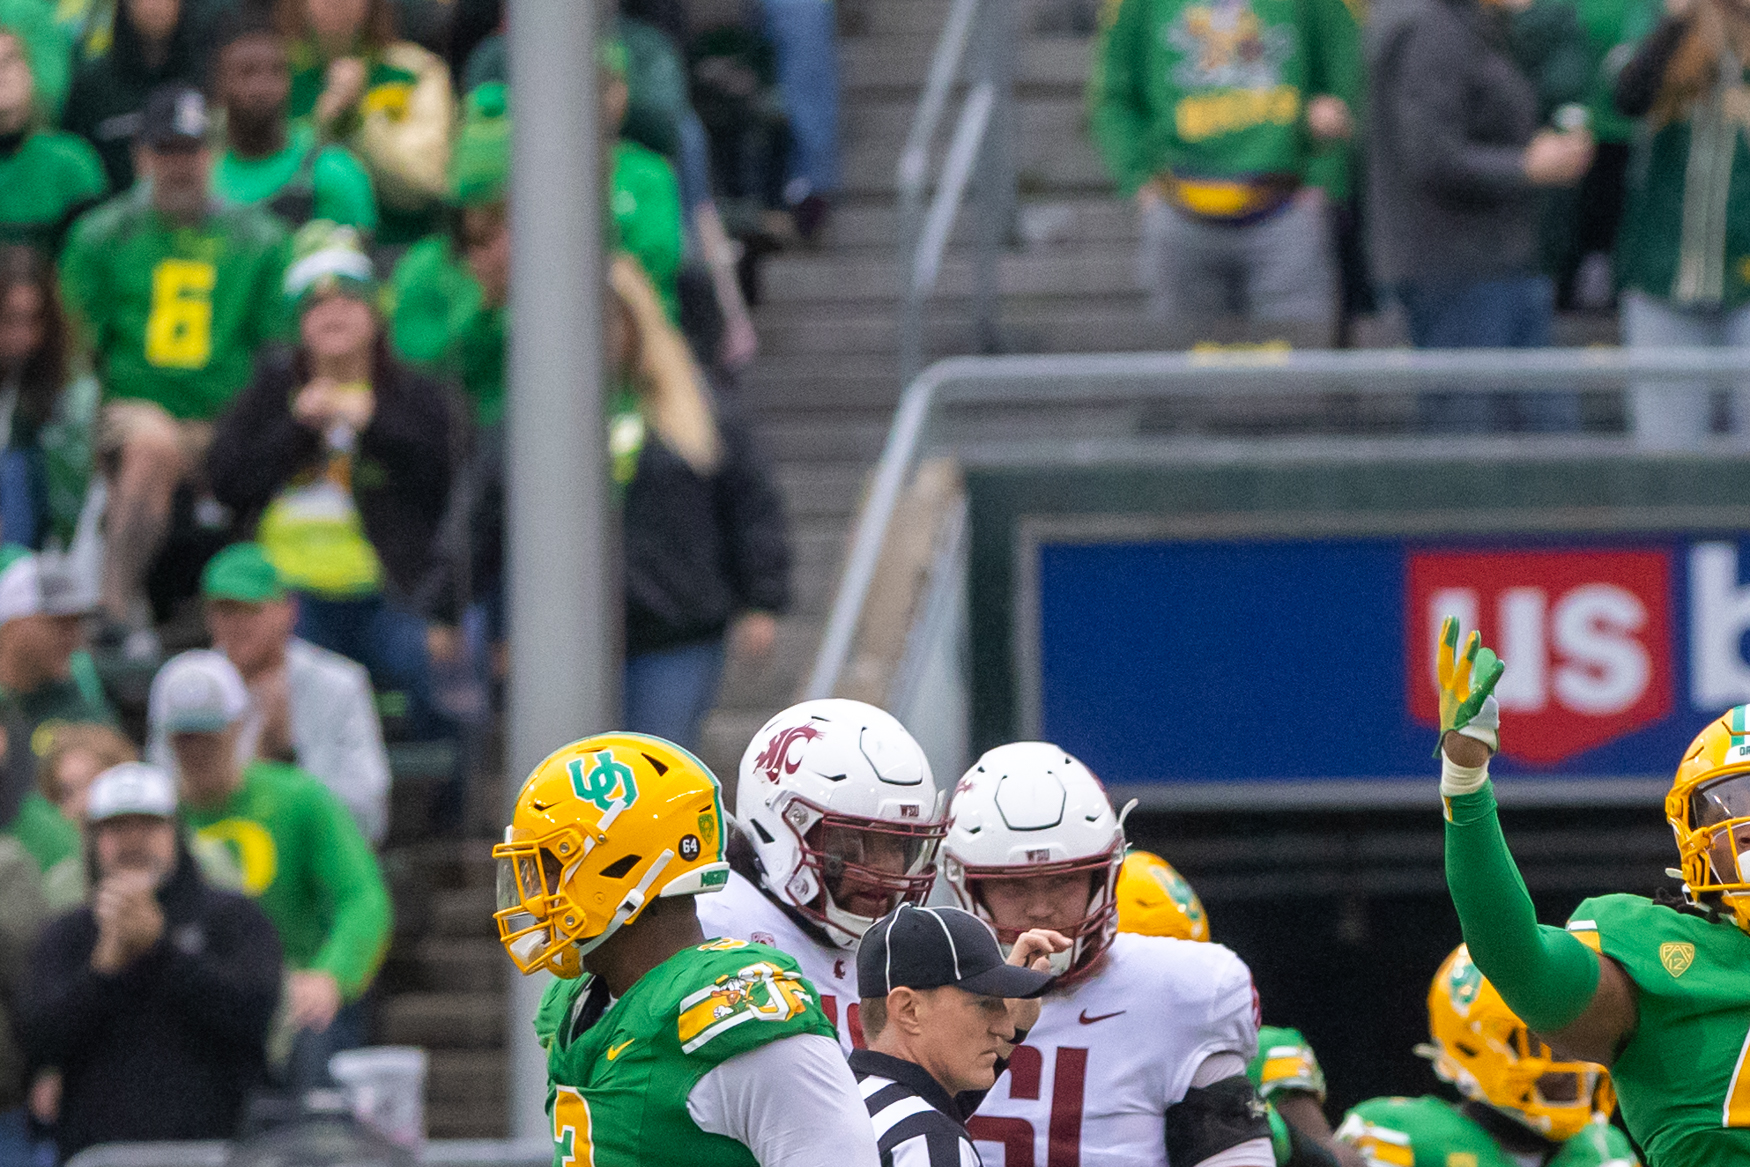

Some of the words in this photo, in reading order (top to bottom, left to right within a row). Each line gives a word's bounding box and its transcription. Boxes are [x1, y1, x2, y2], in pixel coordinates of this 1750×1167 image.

[146, 259, 216, 368] 6
[1428, 583, 1653, 714] us
[900, 804, 919, 817] WSU
[682, 838, 698, 853] 64
[1662, 944, 1694, 964] PAC
[1668, 957, 1686, 970] 12
